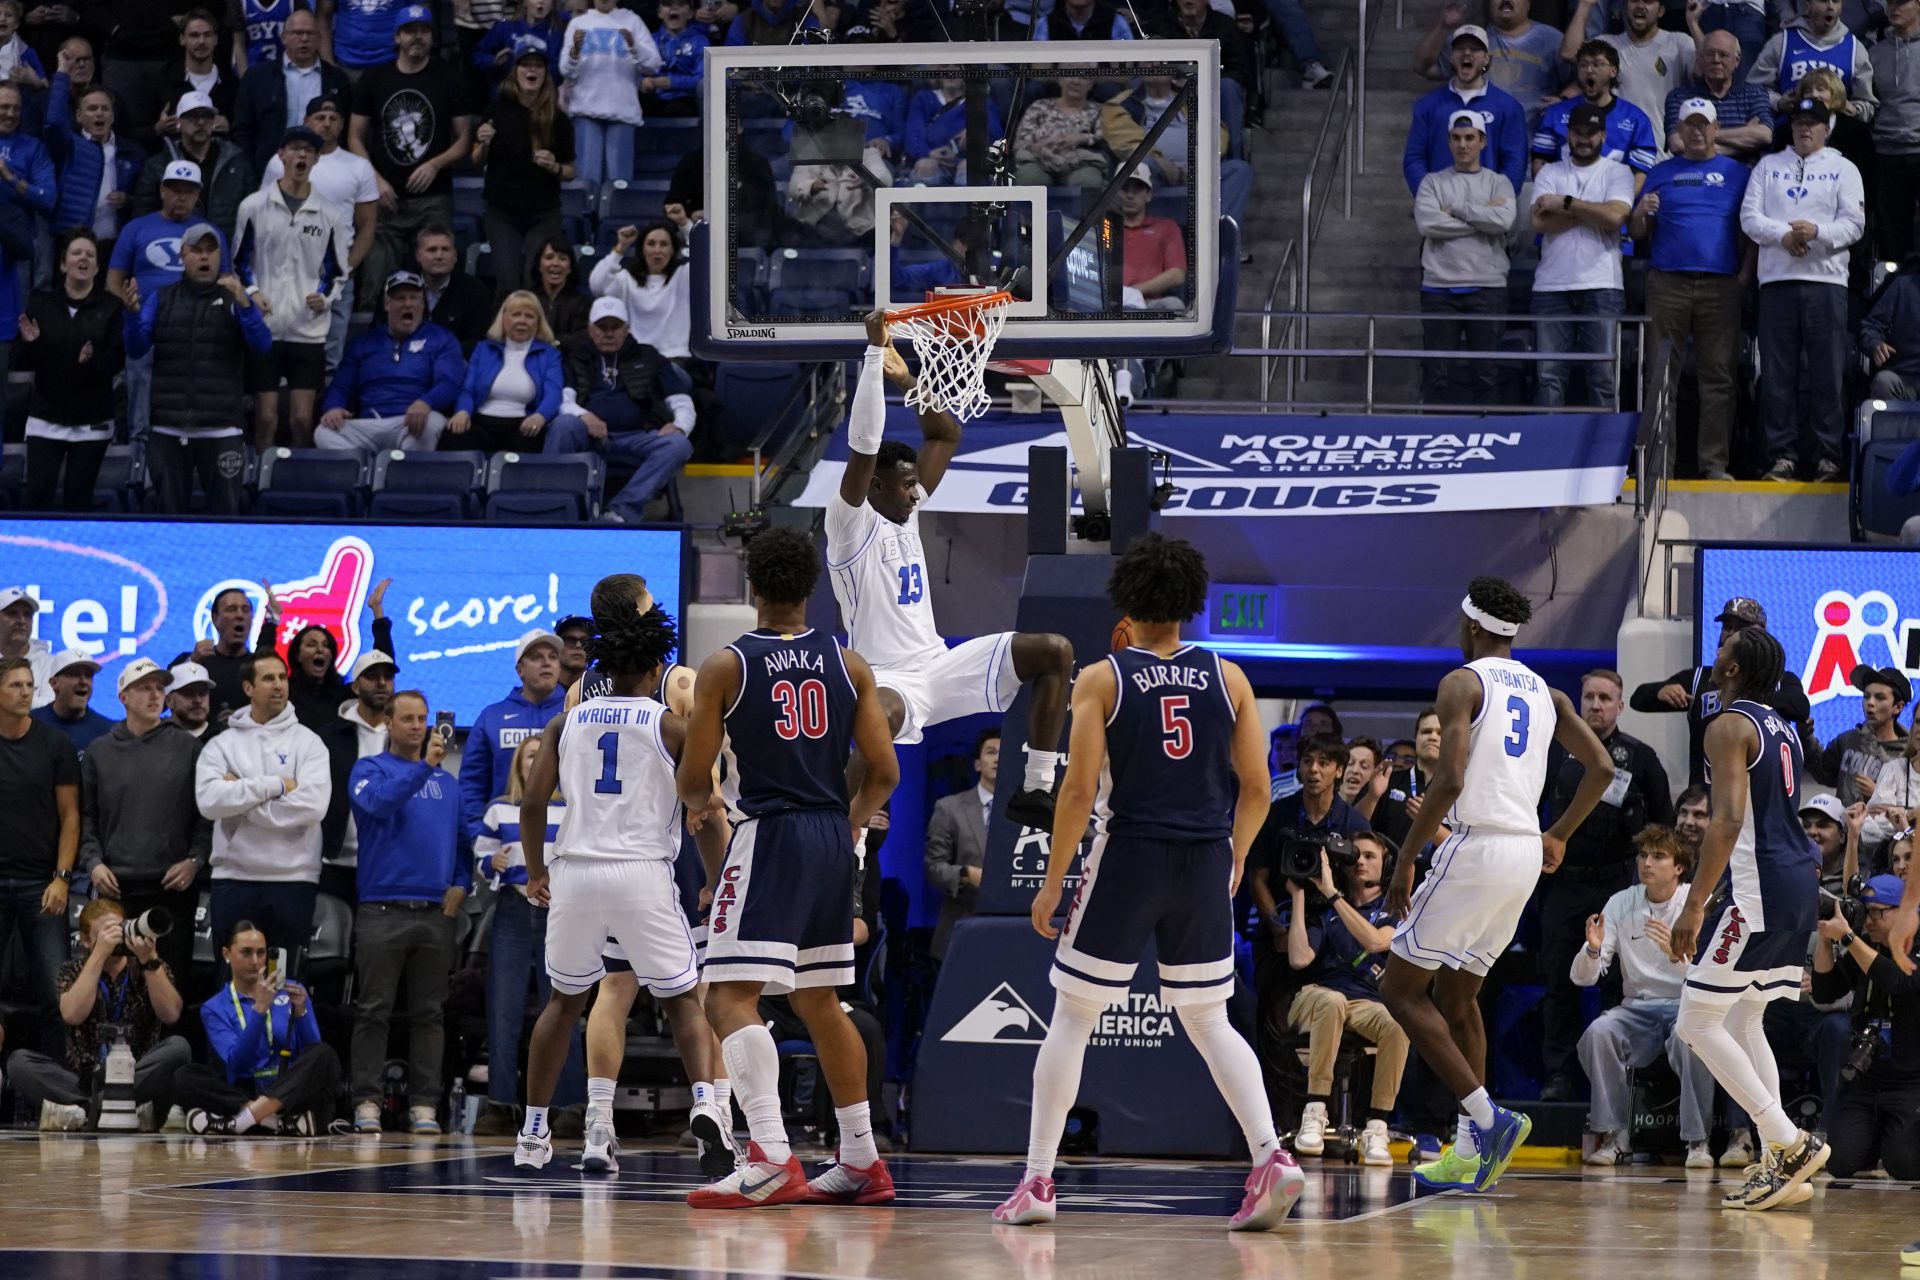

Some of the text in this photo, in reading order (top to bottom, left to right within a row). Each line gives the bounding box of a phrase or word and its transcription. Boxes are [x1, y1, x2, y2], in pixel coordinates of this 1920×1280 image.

[727, 328, 775, 339] SPALDING
[1220, 432, 1521, 450] MOUNTAIN
[1230, 447, 1496, 464] AMERICA
[1259, 462, 1463, 472] CREDIT UNION
[898, 563, 923, 605] 13
[407, 573, 559, 636] score!
[1221, 592, 1267, 629] EXIT
[1732, 598, 1744, 612] Y
[764, 649, 825, 677] AWAKA
[584, 677, 614, 701] KHAR
[1131, 665, 1210, 694] BURRIES
[1489, 668, 1539, 693] DYBANTSA
[577, 708, 651, 725] WRIGHT III
[772, 679, 829, 740] 30
[1701, 689, 1723, 720] B
[1160, 695, 1194, 760] 5
[1504, 694, 1530, 758] 3
[278, 753, 288, 765] Y
[595, 732, 622, 794] 1
[1780, 742, 1795, 797] 0
[1841, 749, 1882, 782] COUG
[413, 779, 443, 799] YU
[713, 865, 741, 934] CATS
[1712, 906, 1746, 965] CATS
[1124, 1038, 1162, 1047] UNION
